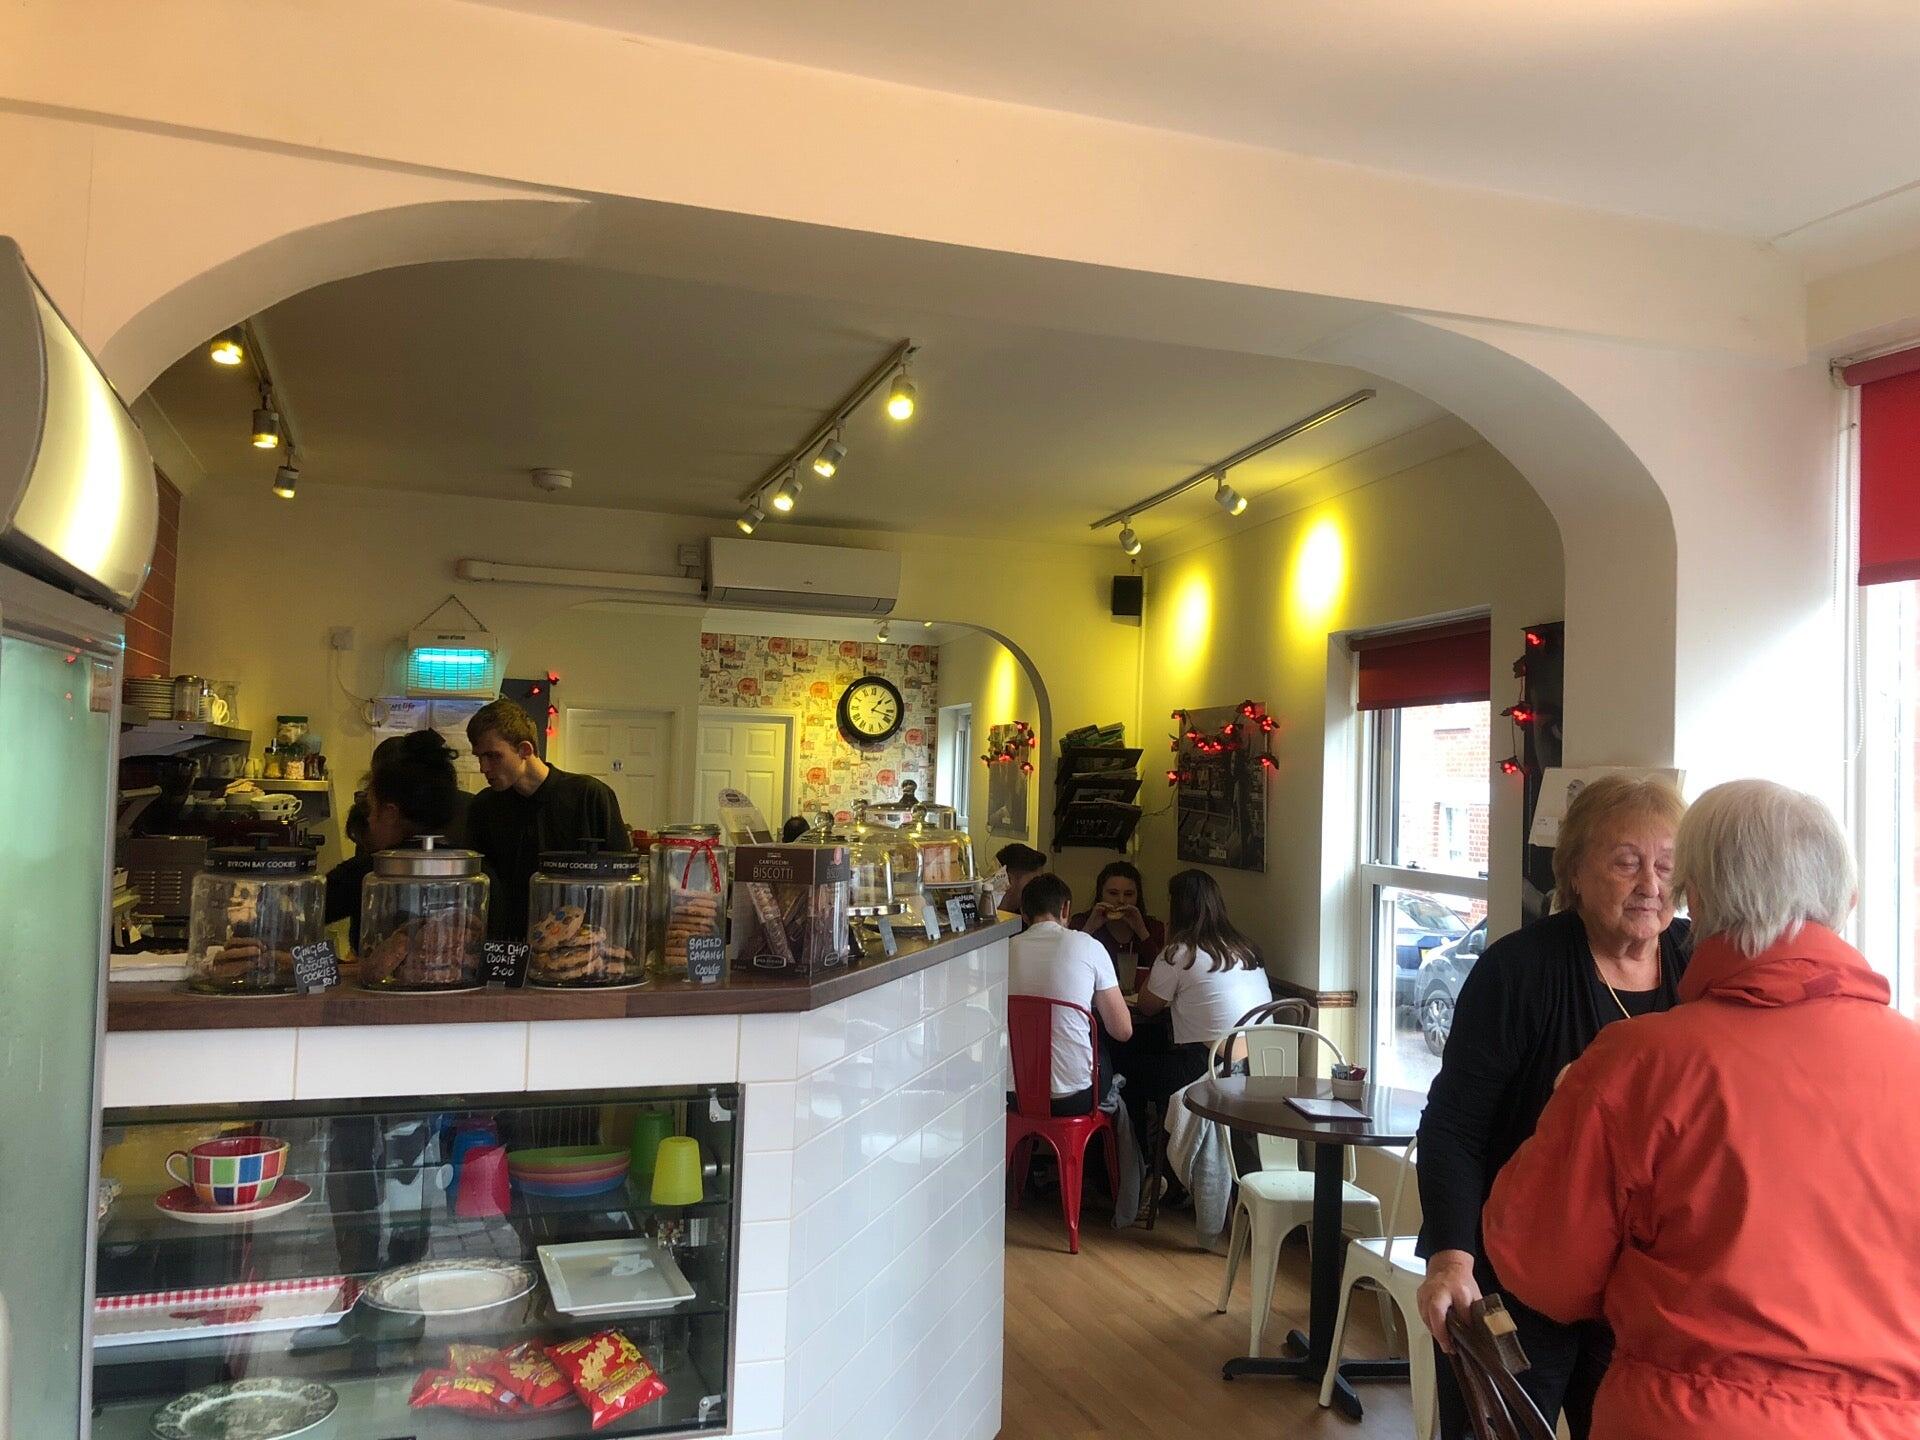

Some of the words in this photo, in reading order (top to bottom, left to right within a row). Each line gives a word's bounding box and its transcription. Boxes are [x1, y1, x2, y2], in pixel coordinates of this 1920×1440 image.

[251, 861, 265, 869] BAY
[569, 862, 598, 870] COOKIES
[753, 867, 794, 880] BISCOTTI
[483, 942, 505, 954] CHOC
[507, 944, 529, 957] CHIP
[689, 937, 722, 950] SALTED
[292, 941, 329, 962] GINGER
[486, 952, 517, 966] COOKIE
[302, 966, 337, 984] COOKIES
